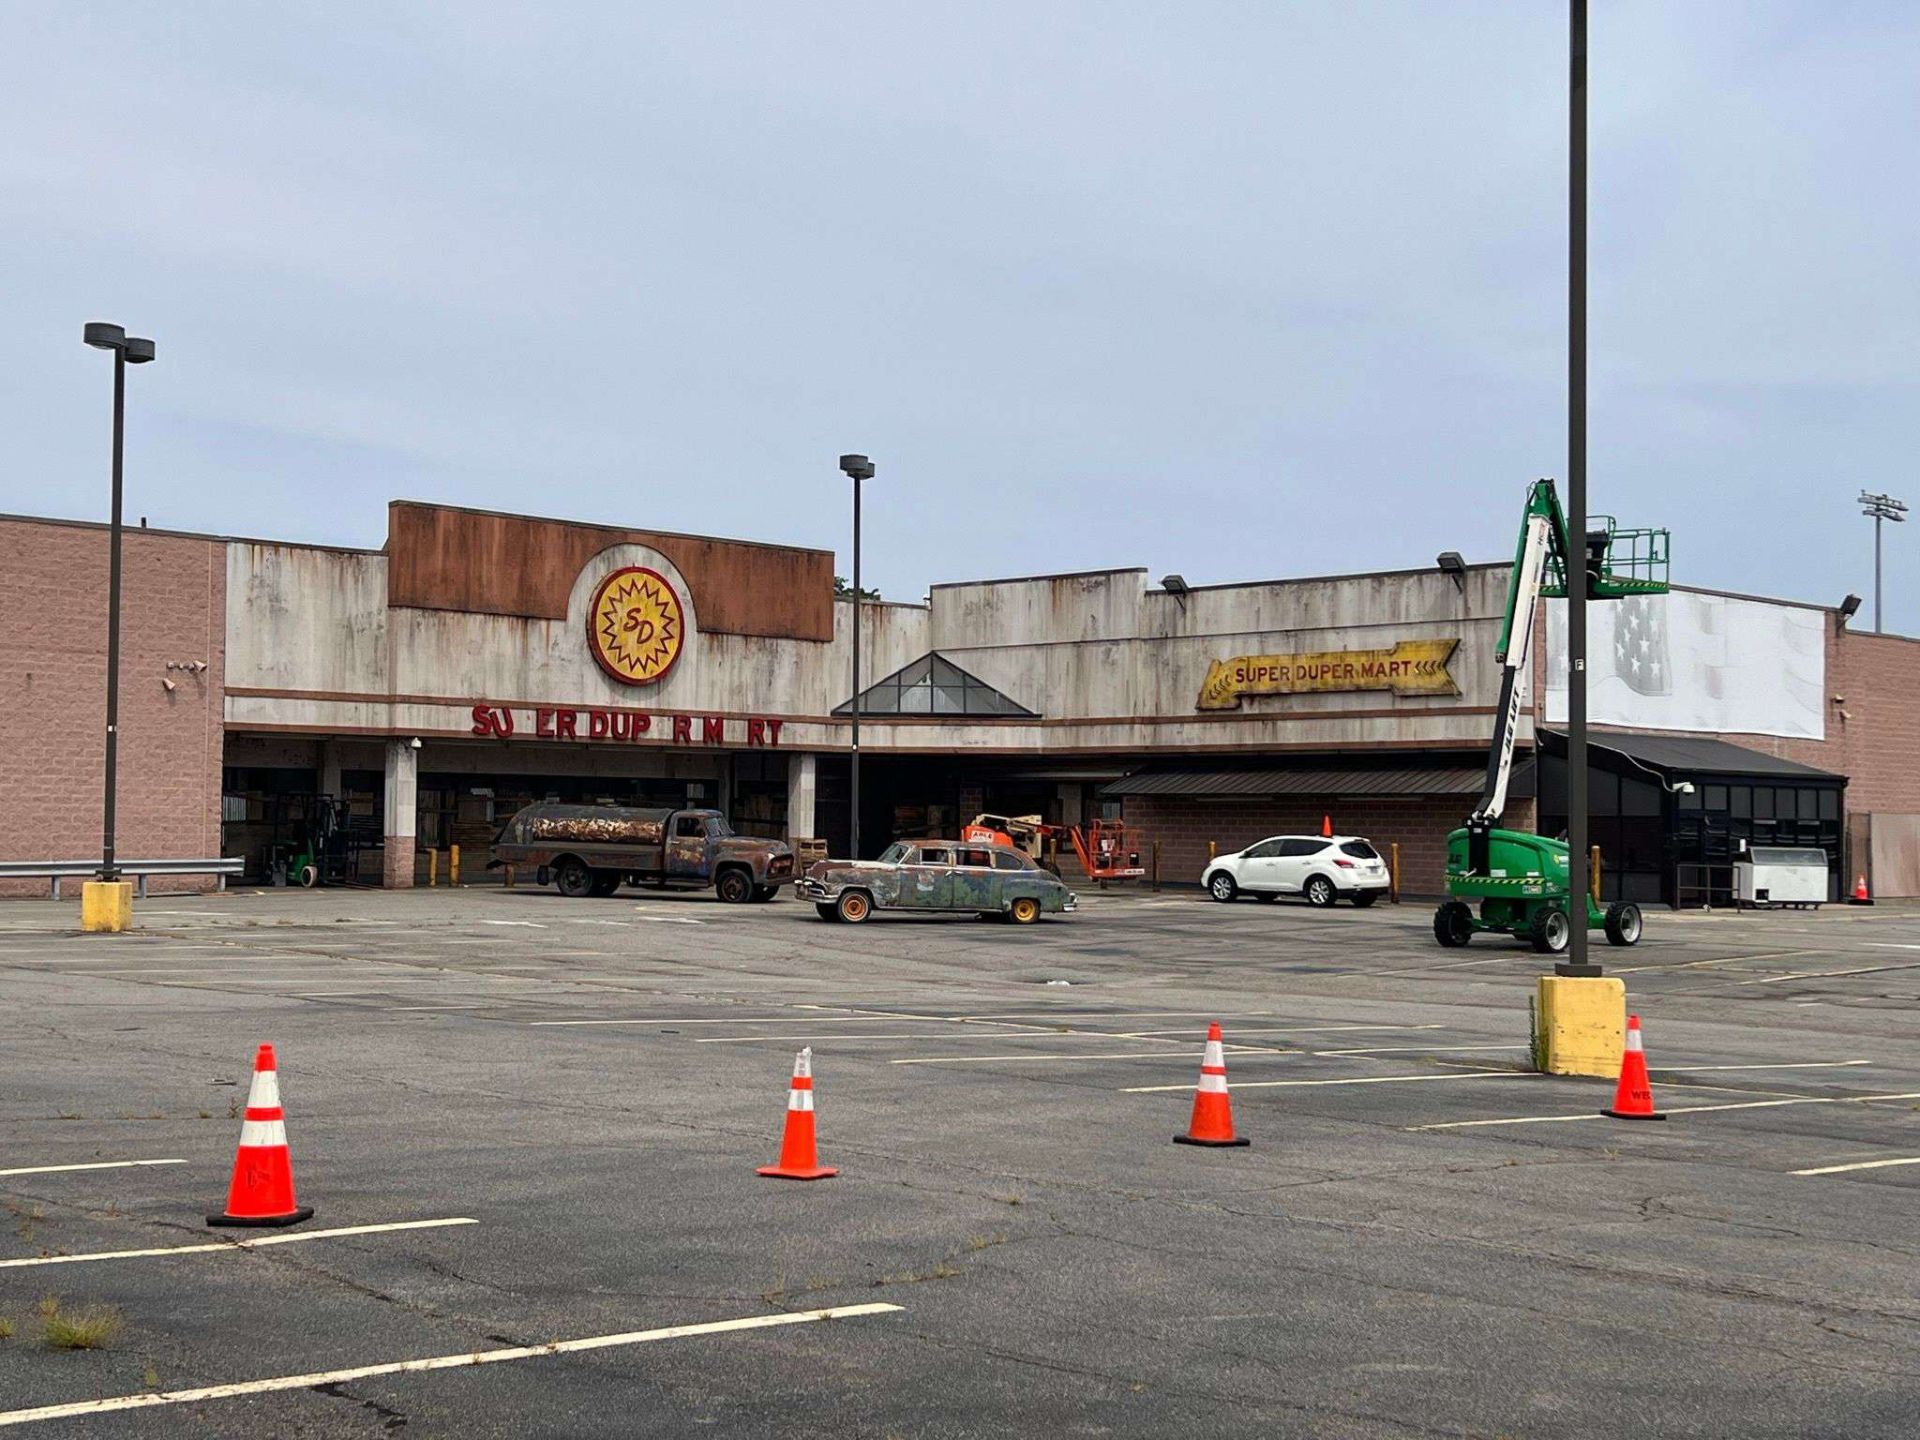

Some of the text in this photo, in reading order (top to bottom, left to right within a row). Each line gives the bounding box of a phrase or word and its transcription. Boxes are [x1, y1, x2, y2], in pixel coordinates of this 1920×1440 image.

[1235, 660, 1412, 683] SUPER DUPER MART
[1510, 686, 1519, 723] LIFT
